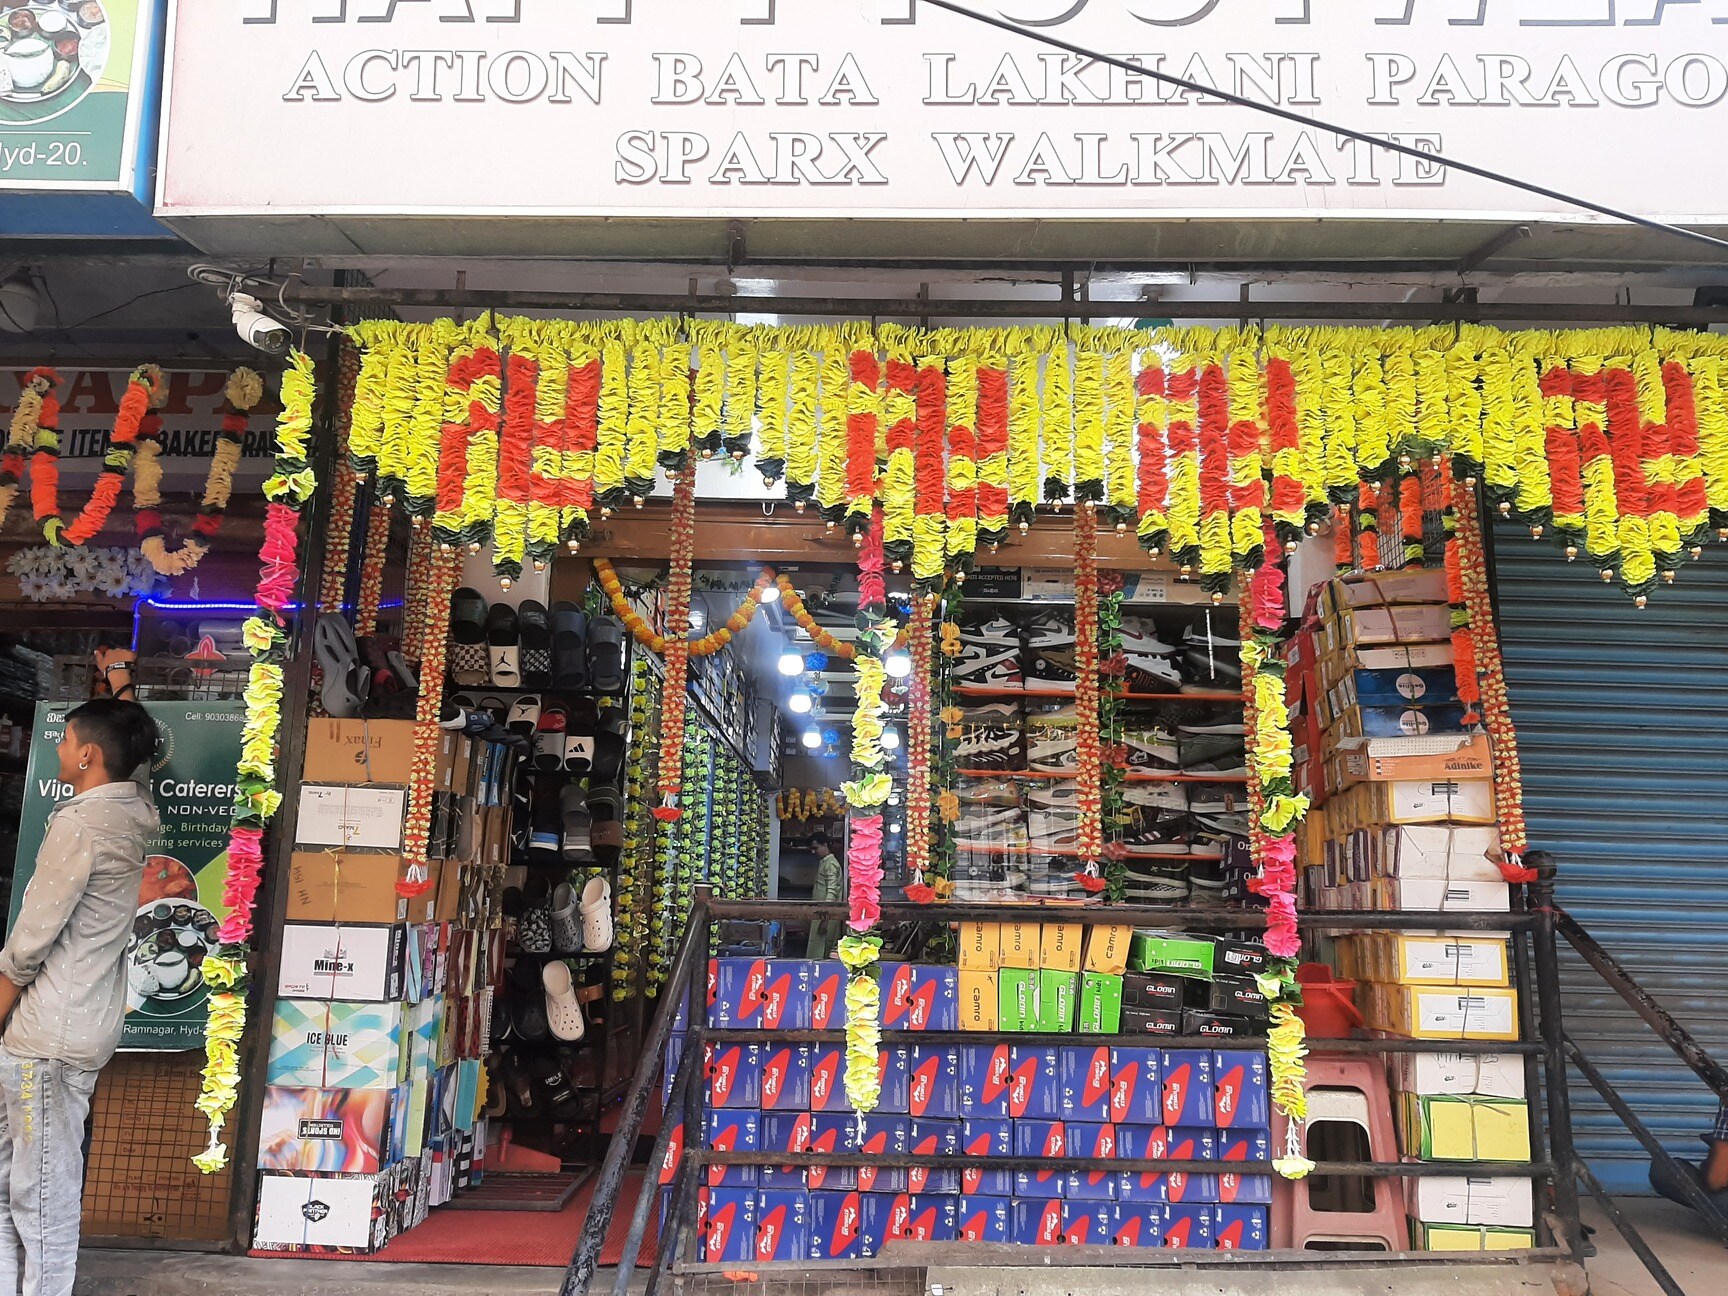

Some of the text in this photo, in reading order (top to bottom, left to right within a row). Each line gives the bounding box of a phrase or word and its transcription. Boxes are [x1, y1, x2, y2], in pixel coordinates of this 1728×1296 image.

[282, 49, 608, 105] ACTION
[650, 52, 879, 106] BATA
[922, 52, 1322, 106] LAKHANI
[0, 142, 87, 171] yd-20.
[615, 130, 1447, 187] SPARX WALKMATE
[204, 712, 249, 723] 90303868
[180, 823, 228, 834] Birthday
[178, 840, 223, 850] services
[1014, 921, 1022, 951] amro
[1056, 921, 1064, 951] amro
[973, 987, 981, 1022] camro
[124, 1024, 204, 1036] Ramnagar, Hyd-
[307, 1032, 348, 1046] ICE BLUE
